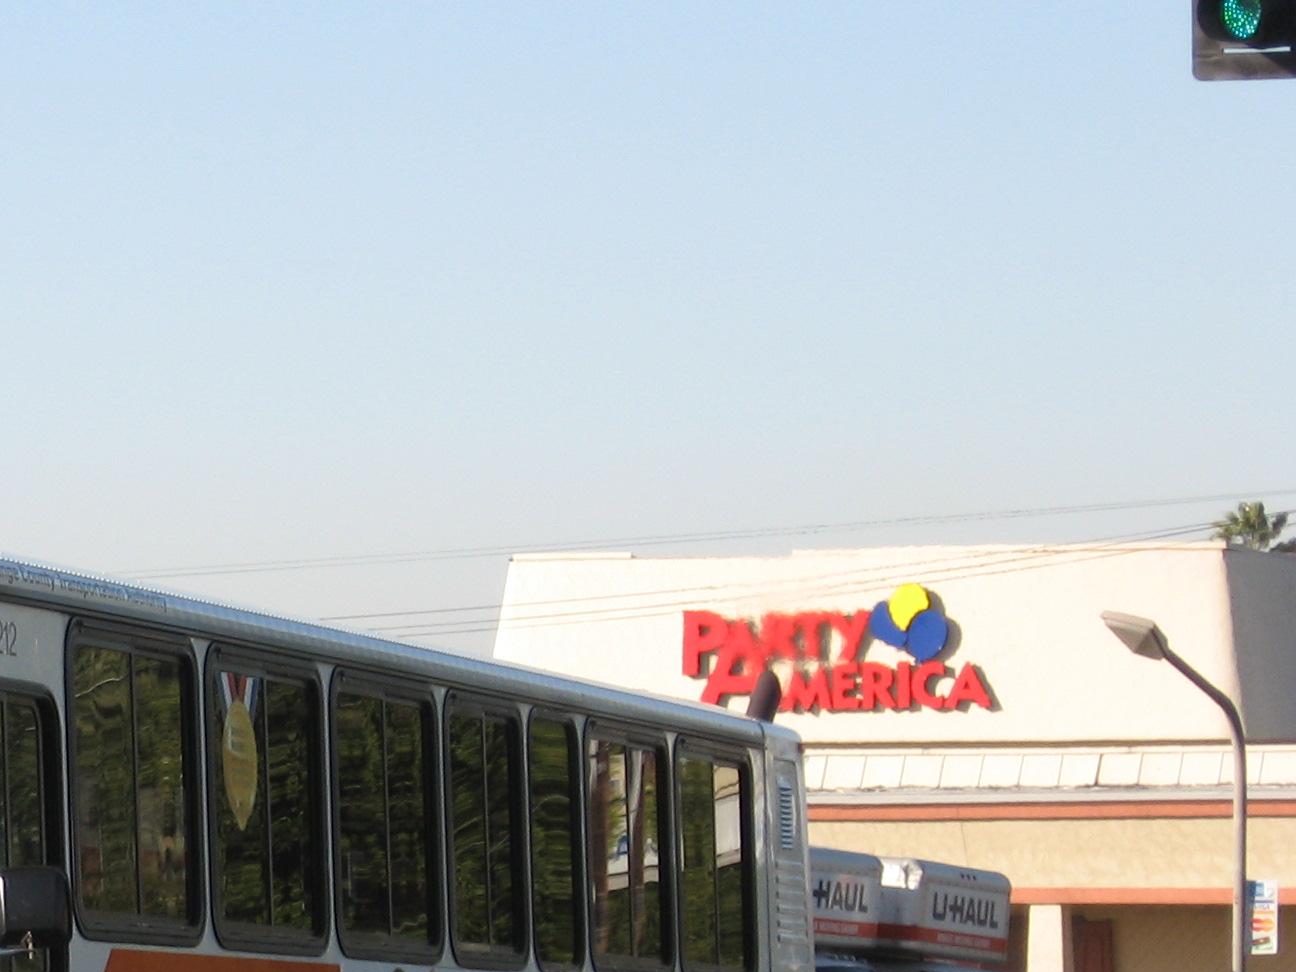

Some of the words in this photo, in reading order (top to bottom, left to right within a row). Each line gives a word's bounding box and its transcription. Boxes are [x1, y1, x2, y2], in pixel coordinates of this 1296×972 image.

[682, 609, 873, 676] PARTY
[700, 640, 992, 712] AMERICA
[812, 879, 869, 913] -HAUL
[932, 891, 999, 929] U-HAUL
